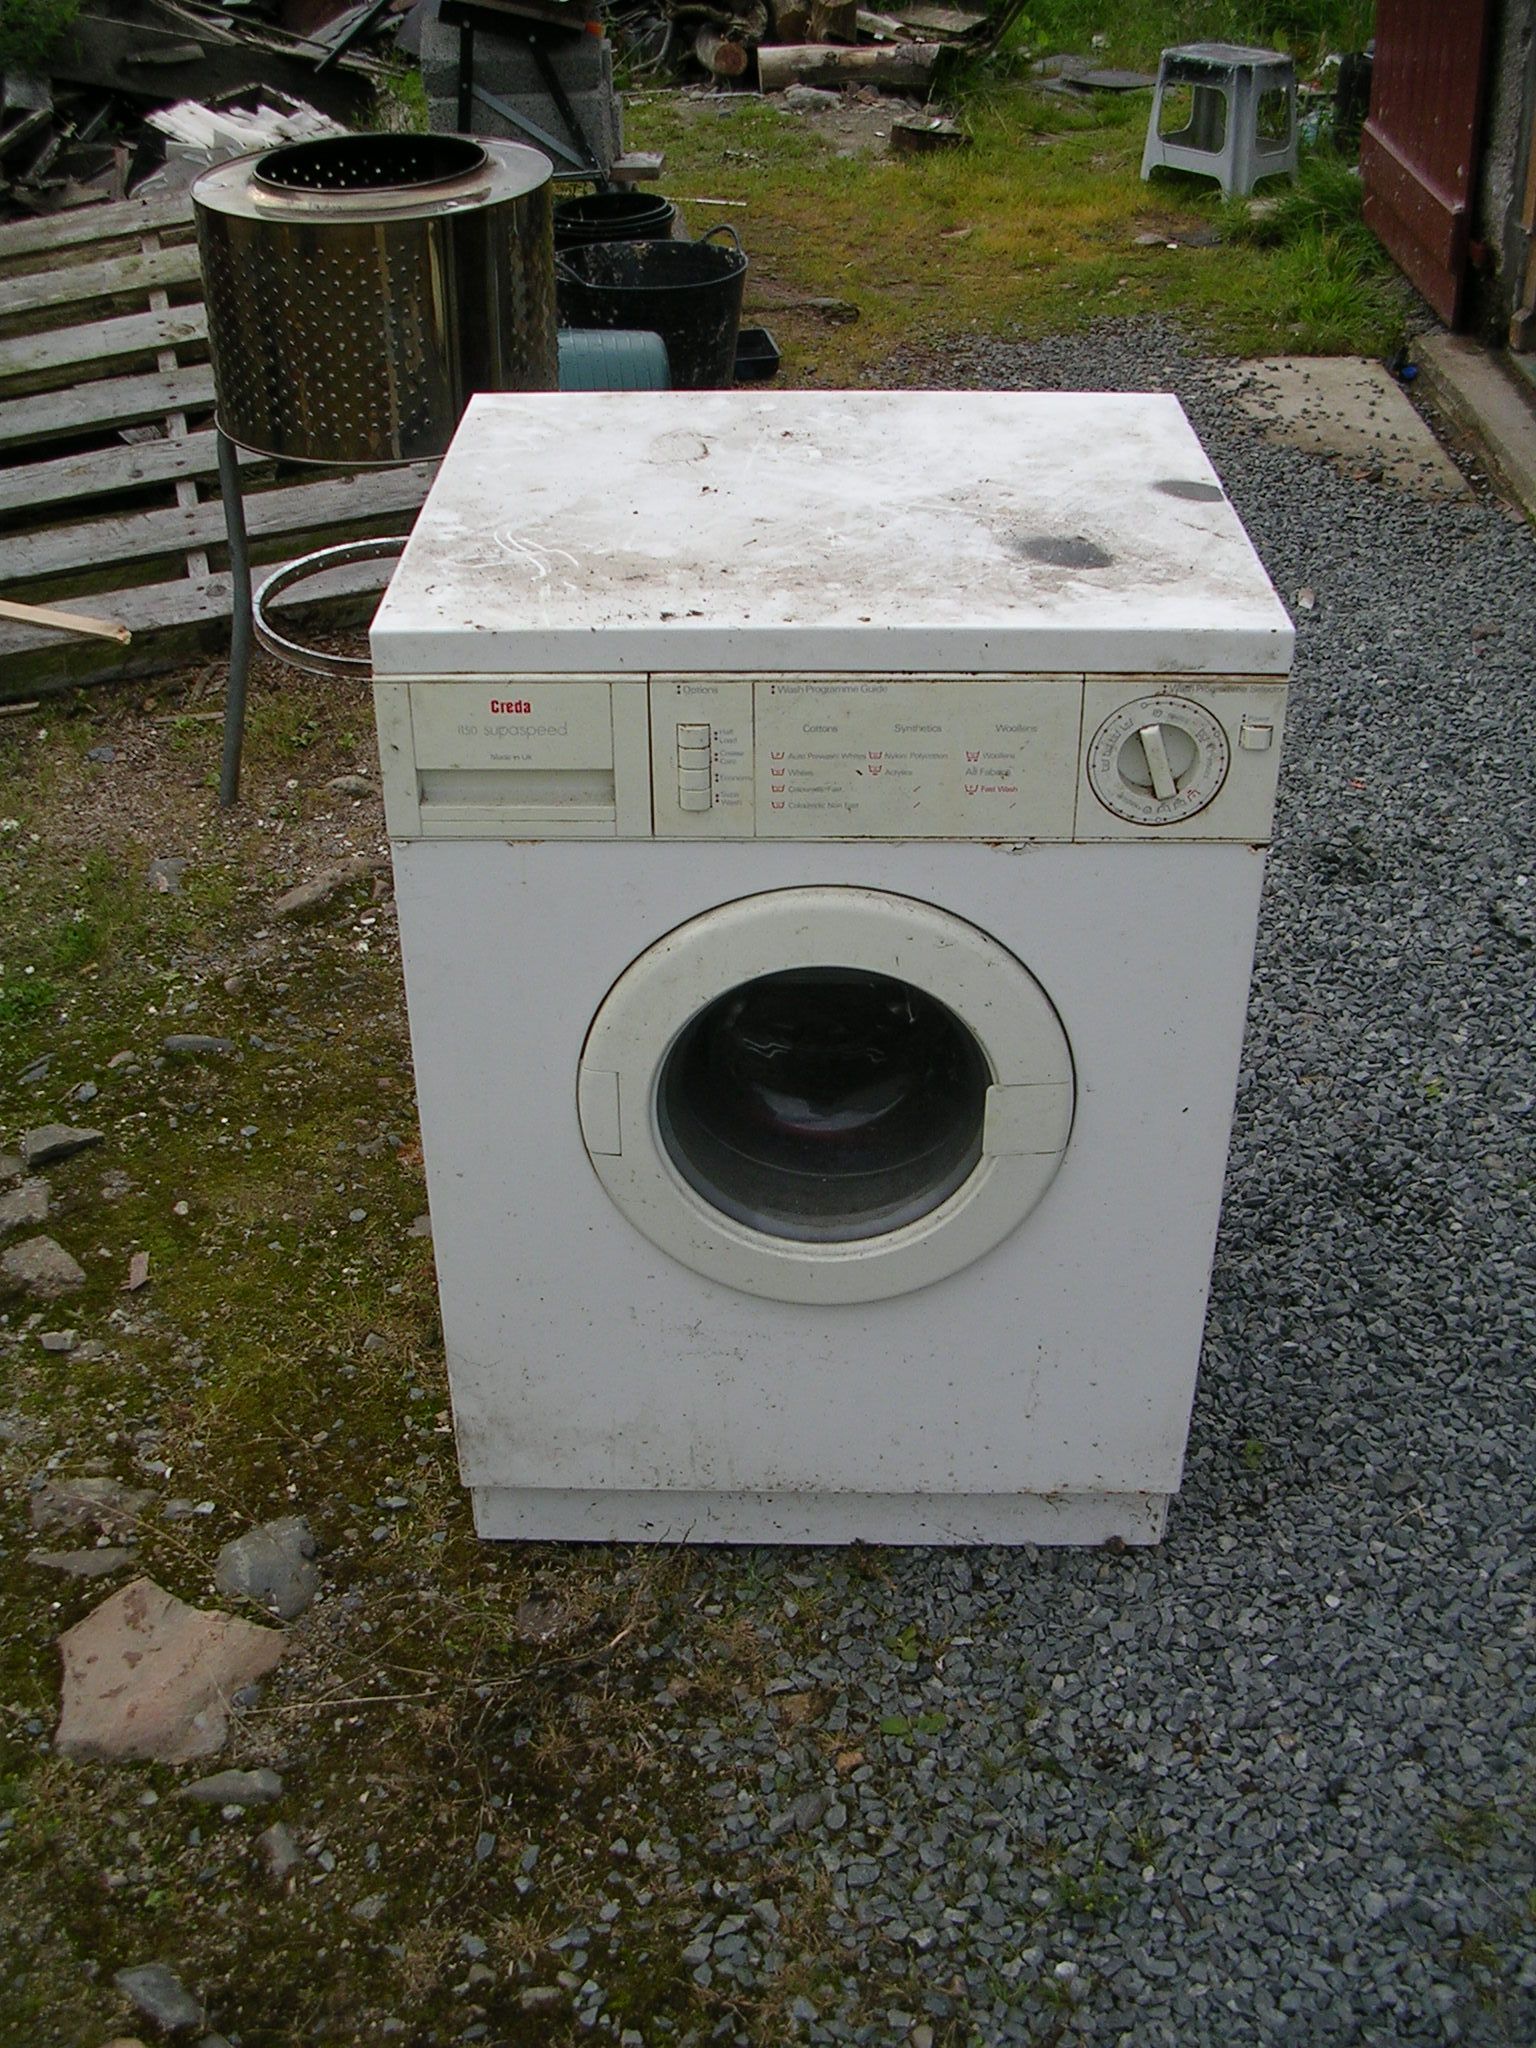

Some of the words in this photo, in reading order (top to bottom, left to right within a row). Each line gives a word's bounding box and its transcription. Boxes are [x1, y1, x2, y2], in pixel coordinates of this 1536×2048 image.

[683, 686, 719, 695] Options
[777, 685, 804, 694] Wash
[805, 685, 858, 697] Programme
[860, 685, 888, 694] Guide
[490, 699, 532, 715] Creda
[483, 721, 568, 740] supaspeed
[802, 724, 838, 733] Cottons
[894, 724, 943, 734] Synthetics
[996, 724, 1038, 733] Woollens
